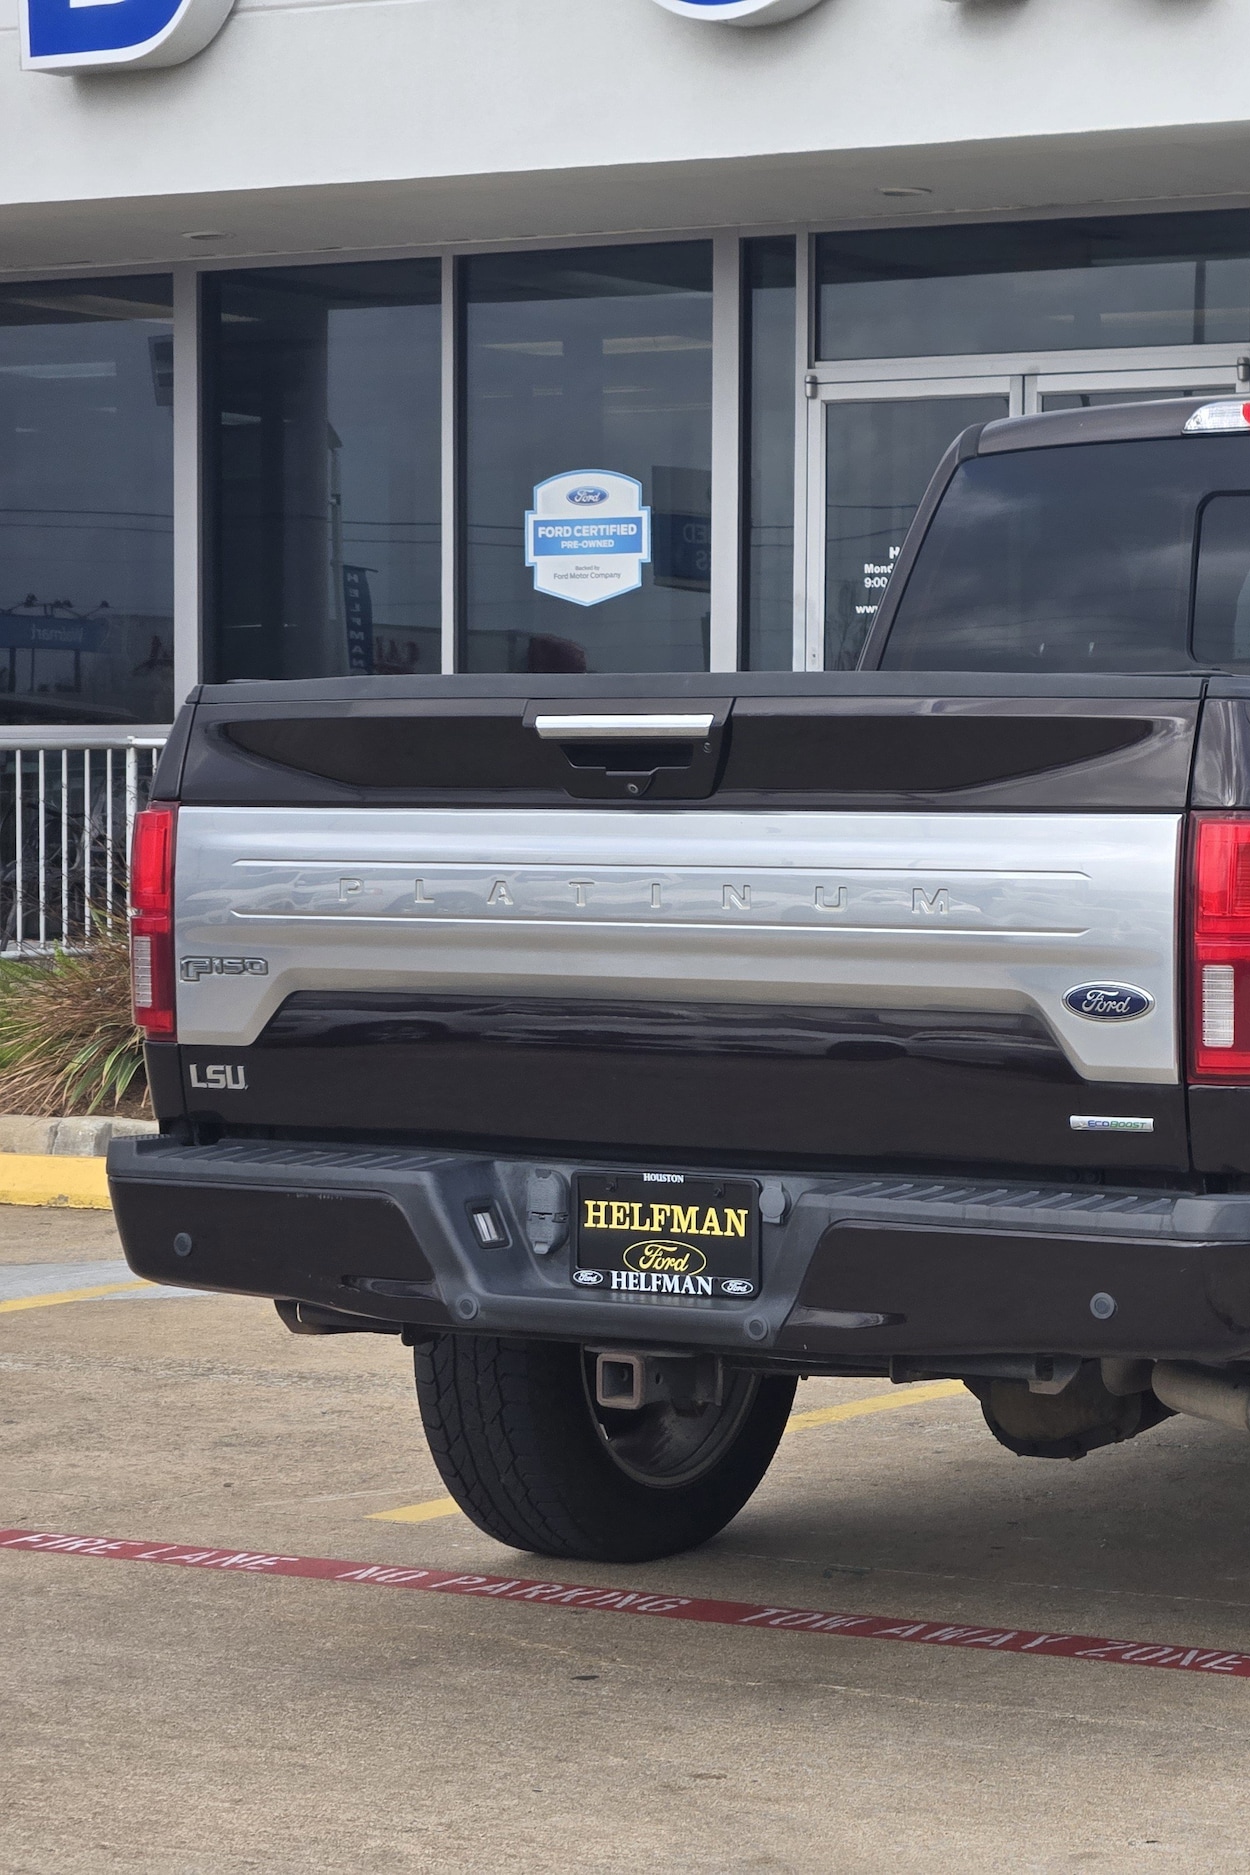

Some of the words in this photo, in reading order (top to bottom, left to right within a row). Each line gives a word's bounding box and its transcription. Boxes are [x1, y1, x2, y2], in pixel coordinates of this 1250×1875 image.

[574, 489, 600, 503] Ford
[538, 525, 573, 538] FORD
[574, 523, 637, 538] CERTIFIED
[561, 539, 615, 549] PRE-OWNED
[554, 572, 568, 580] Ford
[570, 572, 589, 580] Motor
[590, 571, 621, 580] Company
[864, 577, 888, 588] 9:00
[338, 877, 949, 915] PLATINUM
[1081, 988, 1131, 1013] Ford
[189, 1063, 248, 1090] LSU
[1087, 1119, 1148, 1130] ECOBOOST
[643, 1173, 684, 1183] HOUSTON
[584, 1200, 749, 1237] HELFMAN
[638, 1243, 691, 1272] Ford
[578, 1272, 599, 1282] Ford
[610, 1270, 713, 1296] HELFMAN
[726, 1281, 748, 1293] Ford
[3, 1532, 144, 1554] FIRE
[134, 1545, 299, 1570] LANE
[335, 1565, 430, 1583] NO
[429, 1574, 694, 1613] PARKING
[738, 1607, 873, 1630] TOW
[872, 1623, 1072, 1650] AWAY
